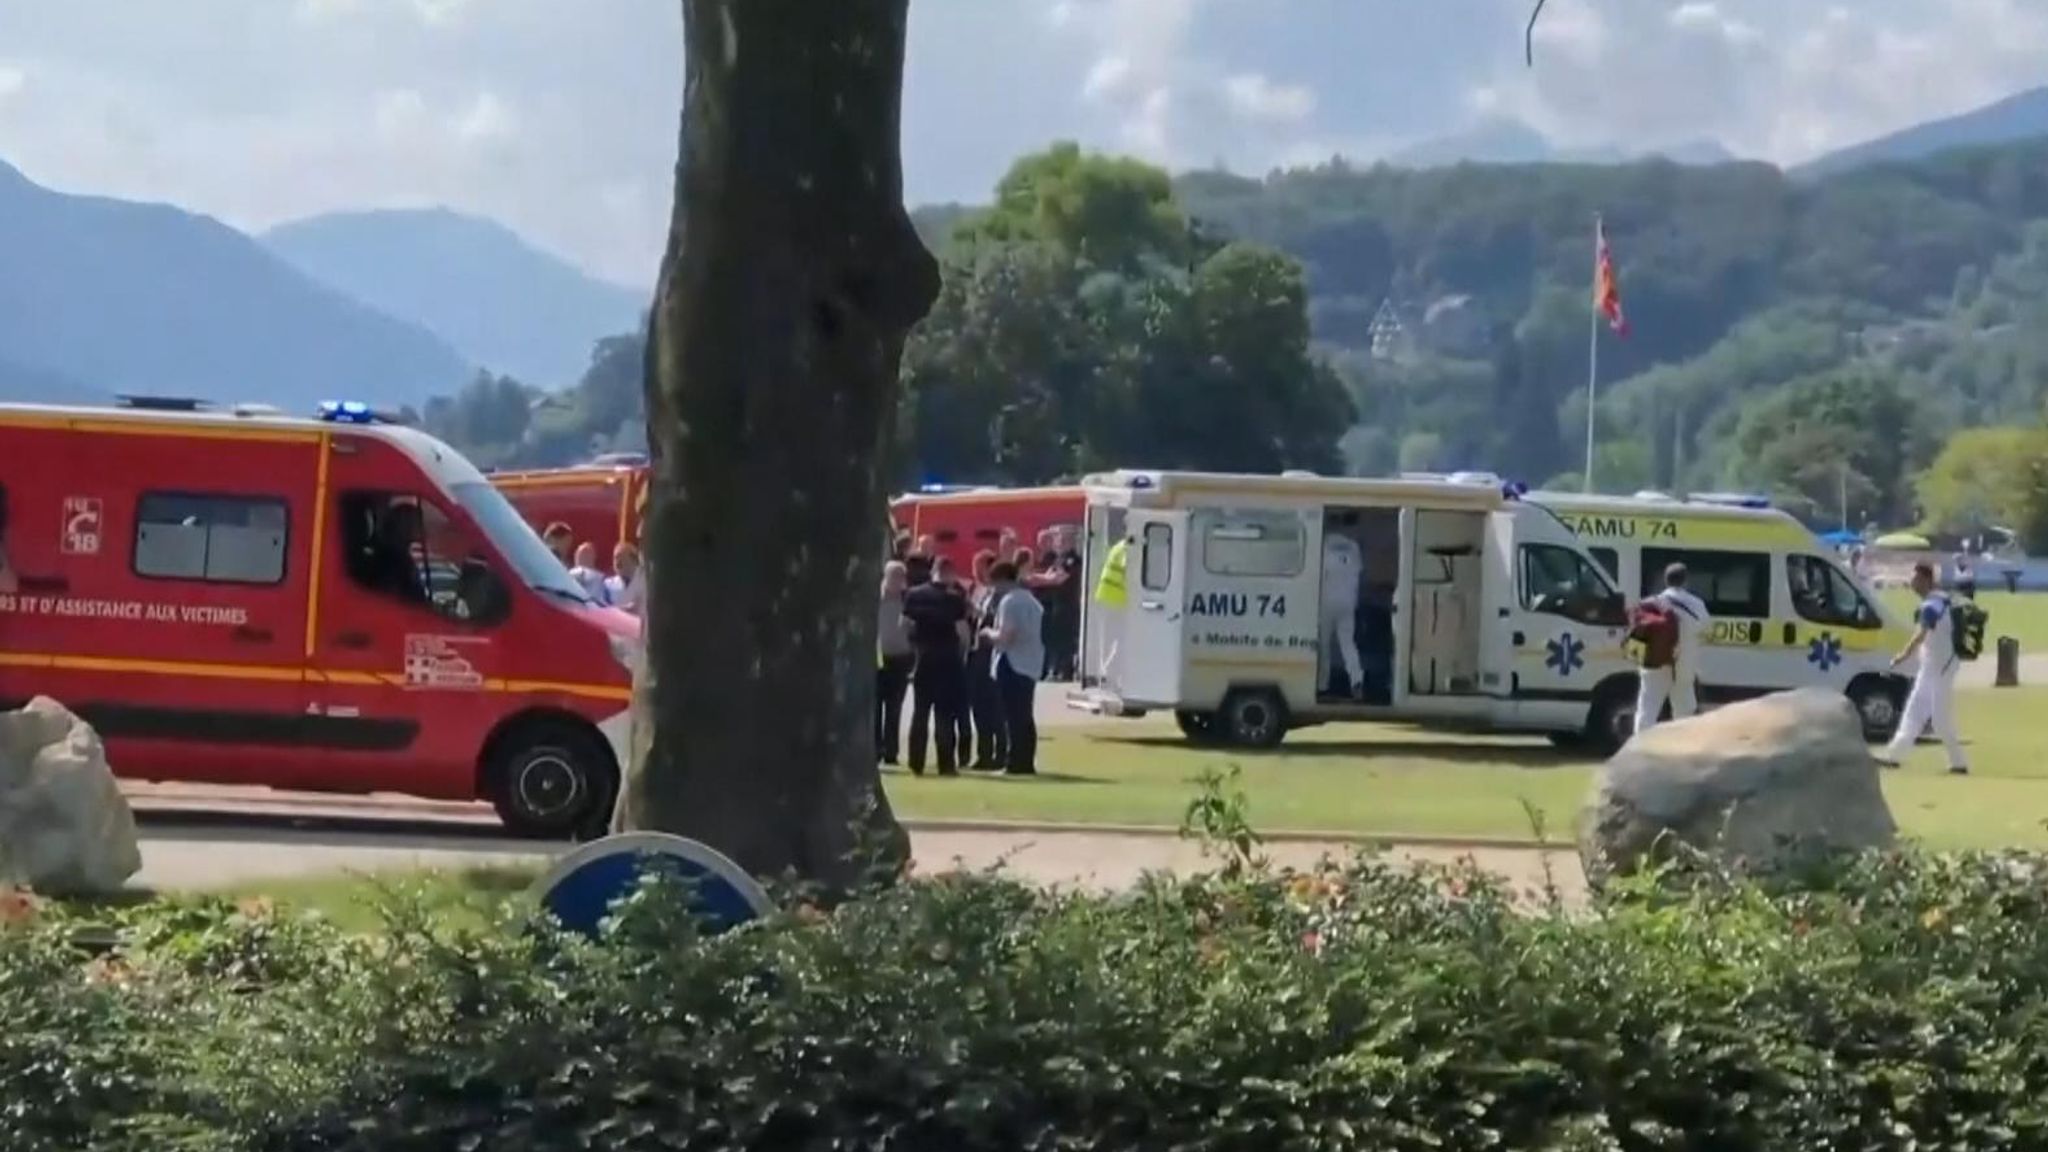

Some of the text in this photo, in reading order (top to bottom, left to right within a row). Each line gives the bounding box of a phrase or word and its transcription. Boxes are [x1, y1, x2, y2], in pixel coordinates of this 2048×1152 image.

[1647, 520, 1677, 539] 74
[20, 596, 36, 613] ET
[39, 597, 142, 619] D'ASSISTANCE
[146, 603, 177, 622] AUX
[180, 604, 248, 625] VICTIMES
[1183, 592, 1286, 617] AMU 74
